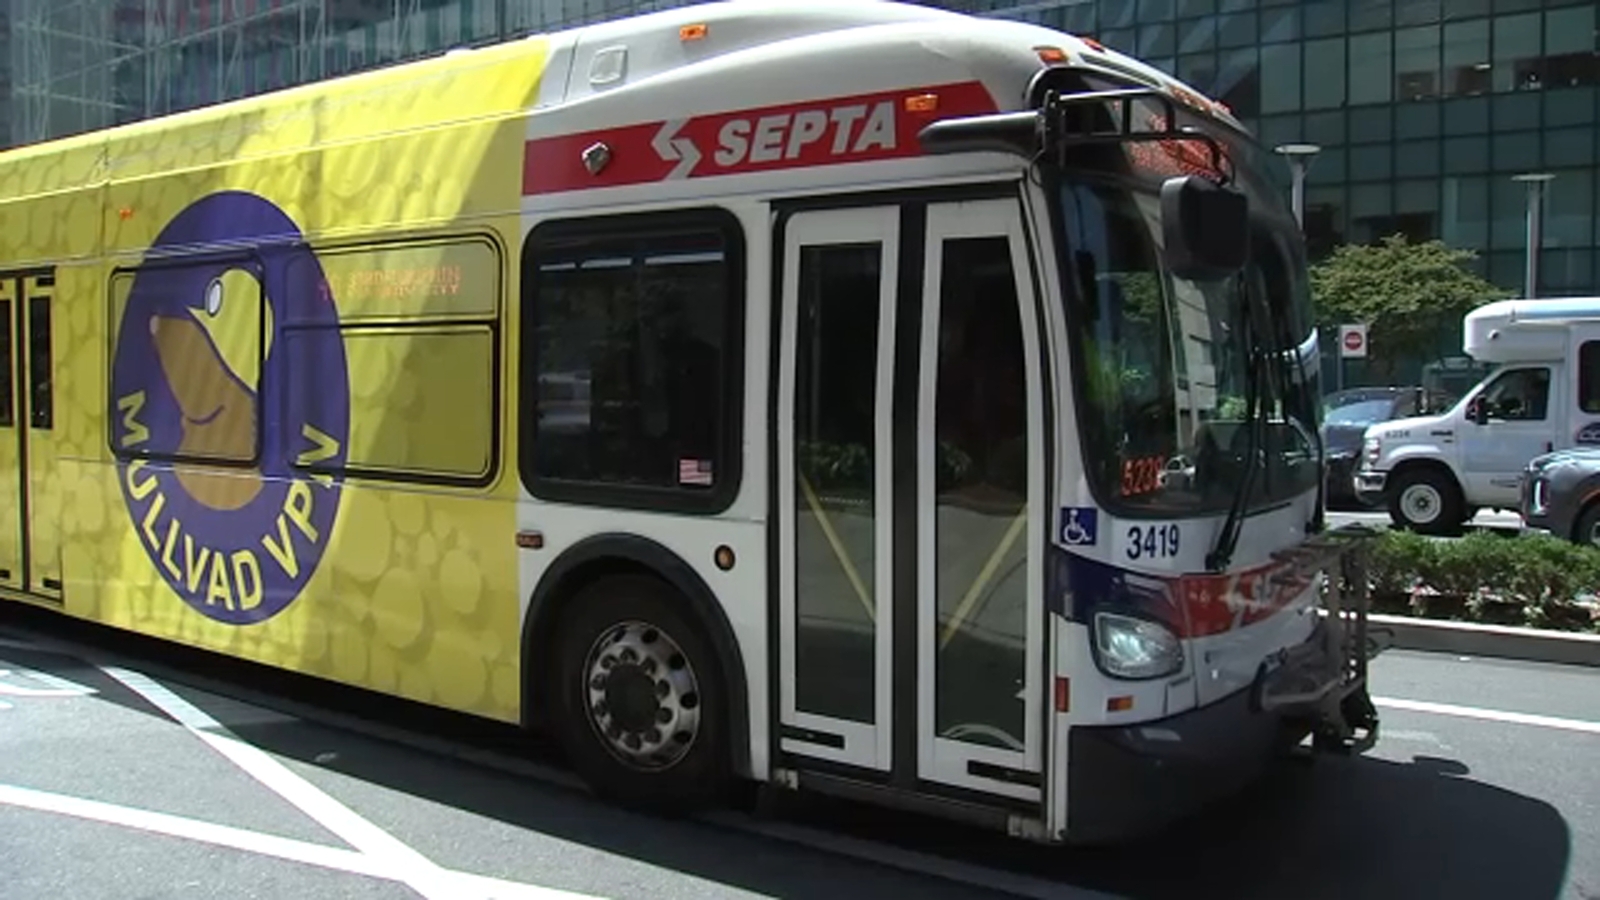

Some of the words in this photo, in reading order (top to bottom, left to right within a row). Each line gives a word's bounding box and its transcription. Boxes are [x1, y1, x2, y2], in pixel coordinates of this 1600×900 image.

[713, 100, 897, 166] SEPTA
[117, 390, 264, 611] MULLVAD
[262, 424, 341, 580] VPN
[1126, 524, 1180, 560] 3419
